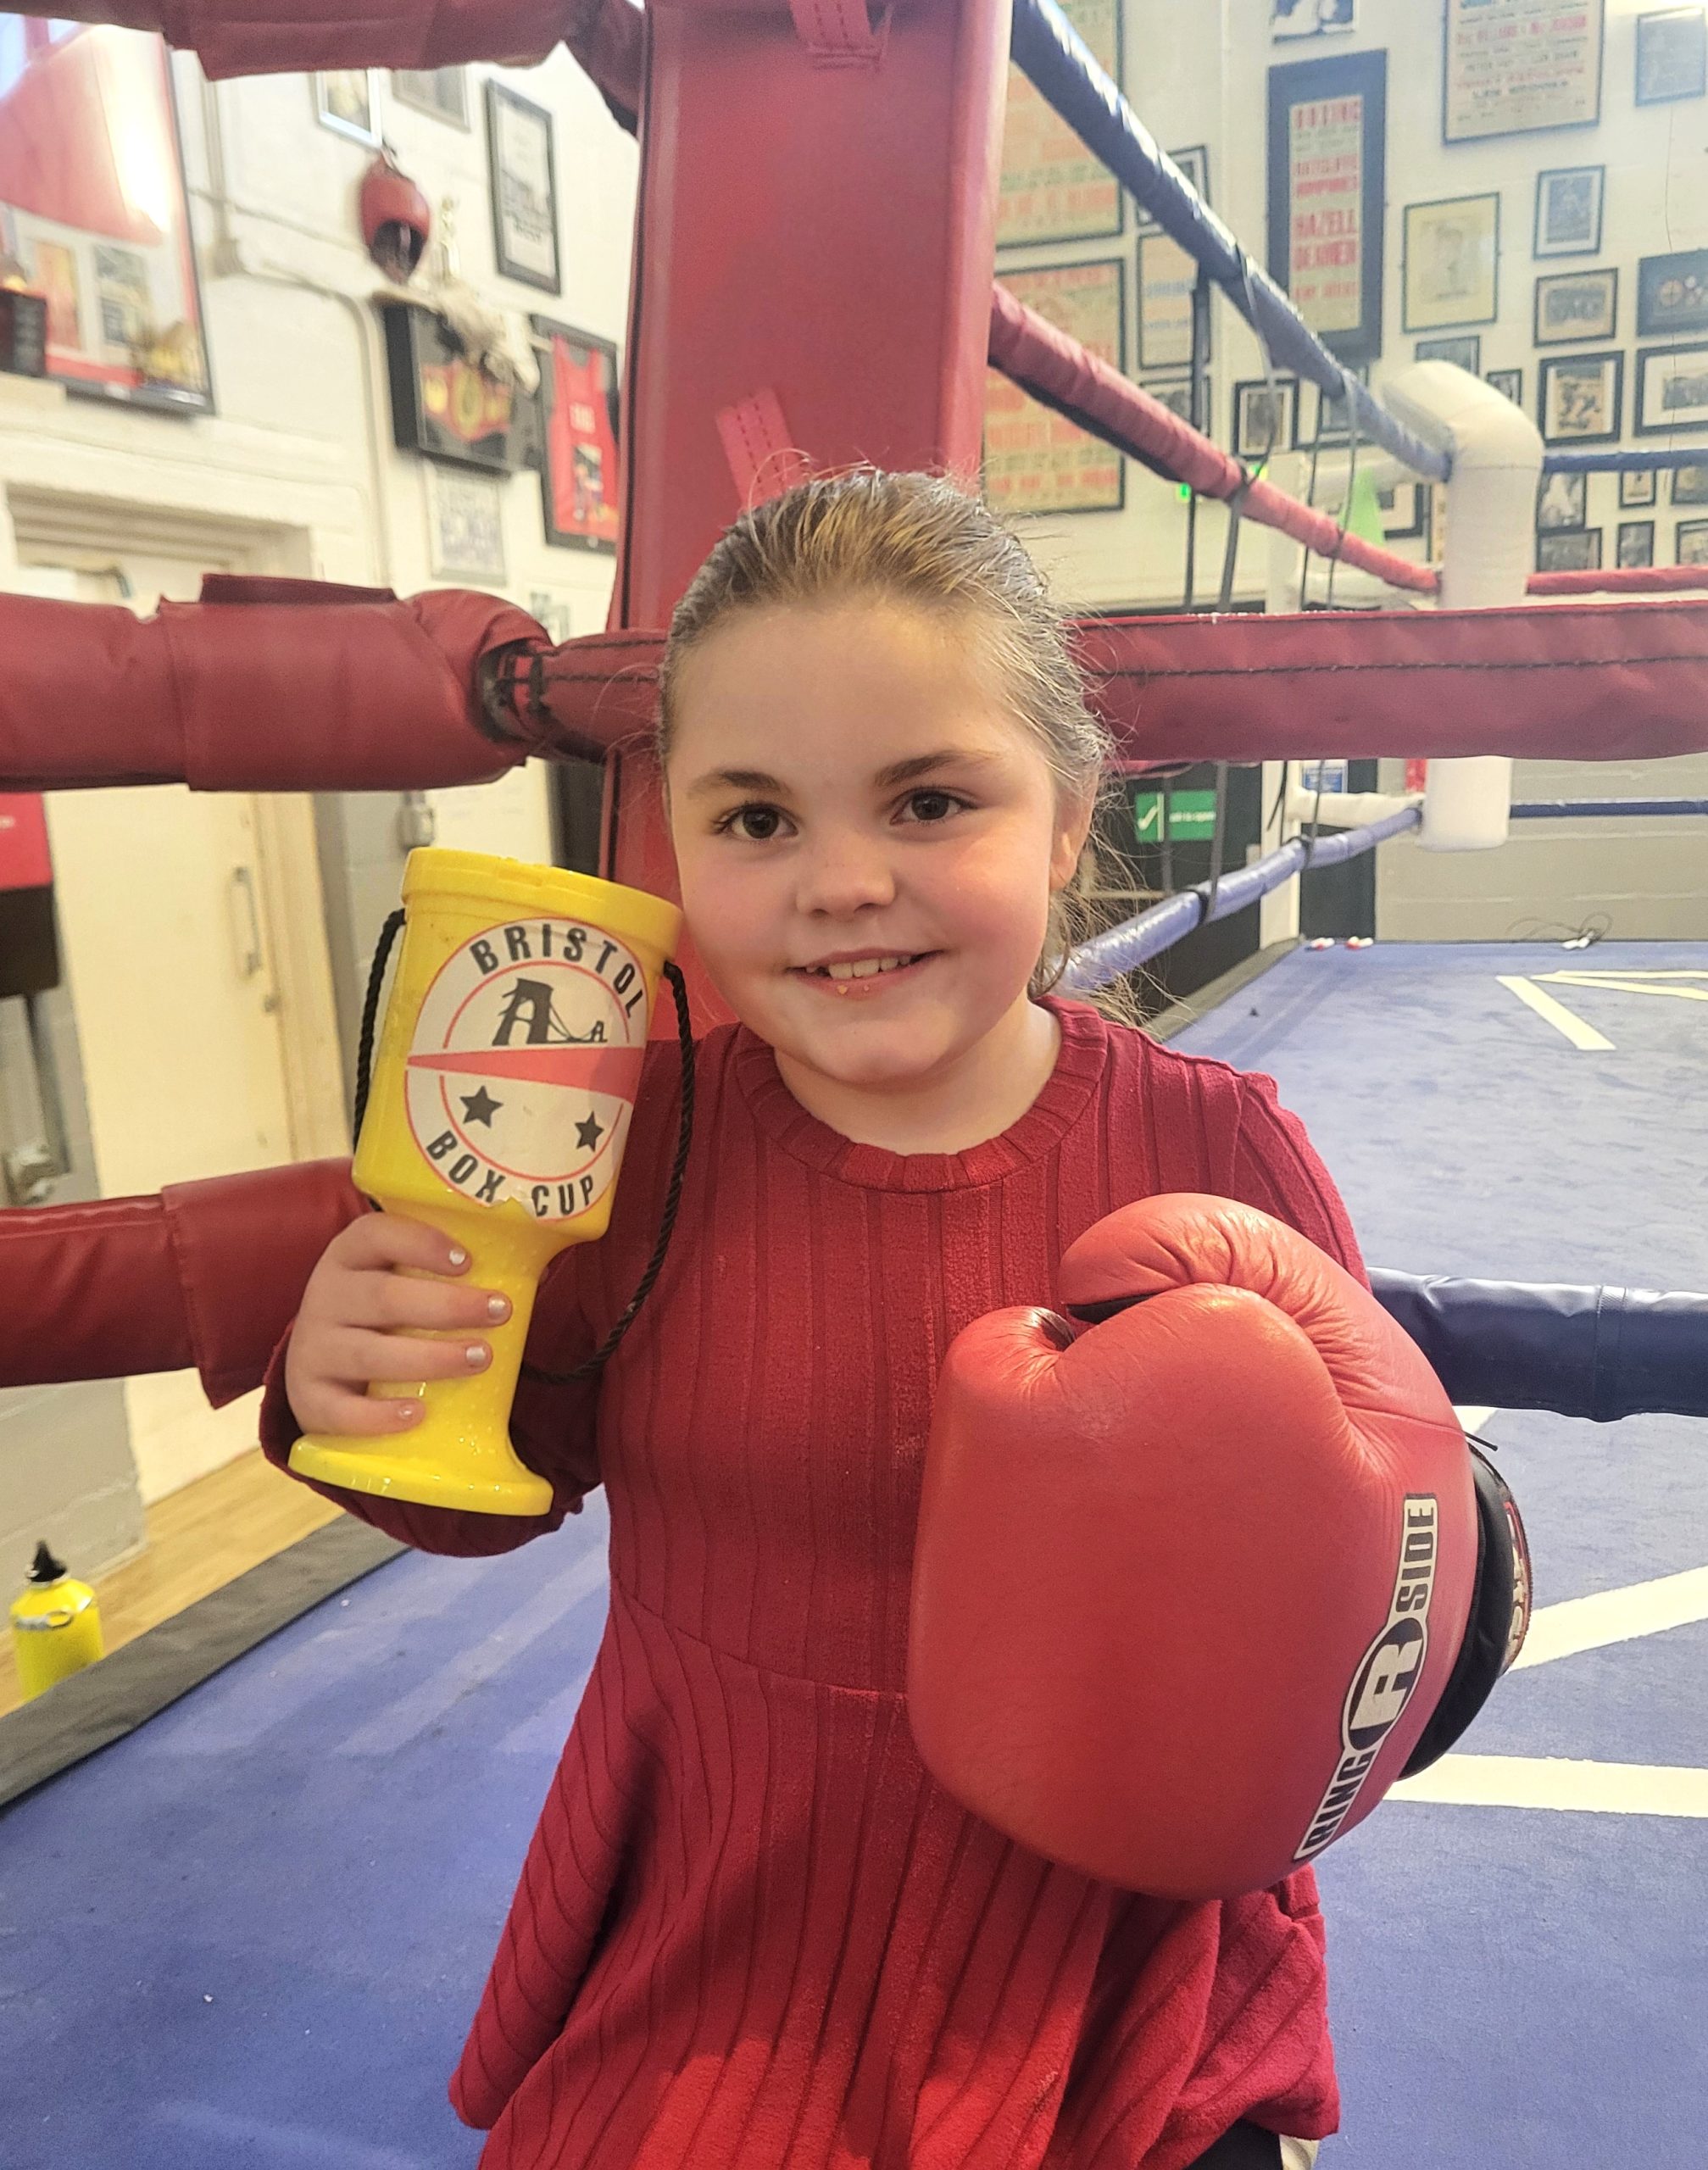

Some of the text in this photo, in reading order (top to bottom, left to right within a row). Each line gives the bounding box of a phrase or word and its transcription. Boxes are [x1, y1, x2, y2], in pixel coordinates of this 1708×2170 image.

[469, 924, 643, 1018] BRISTOL
[426, 1131, 593, 1217] BOX CUP
[1303, 1750, 1376, 1850] RING
[1395, 1507, 1434, 1614] SIDE
